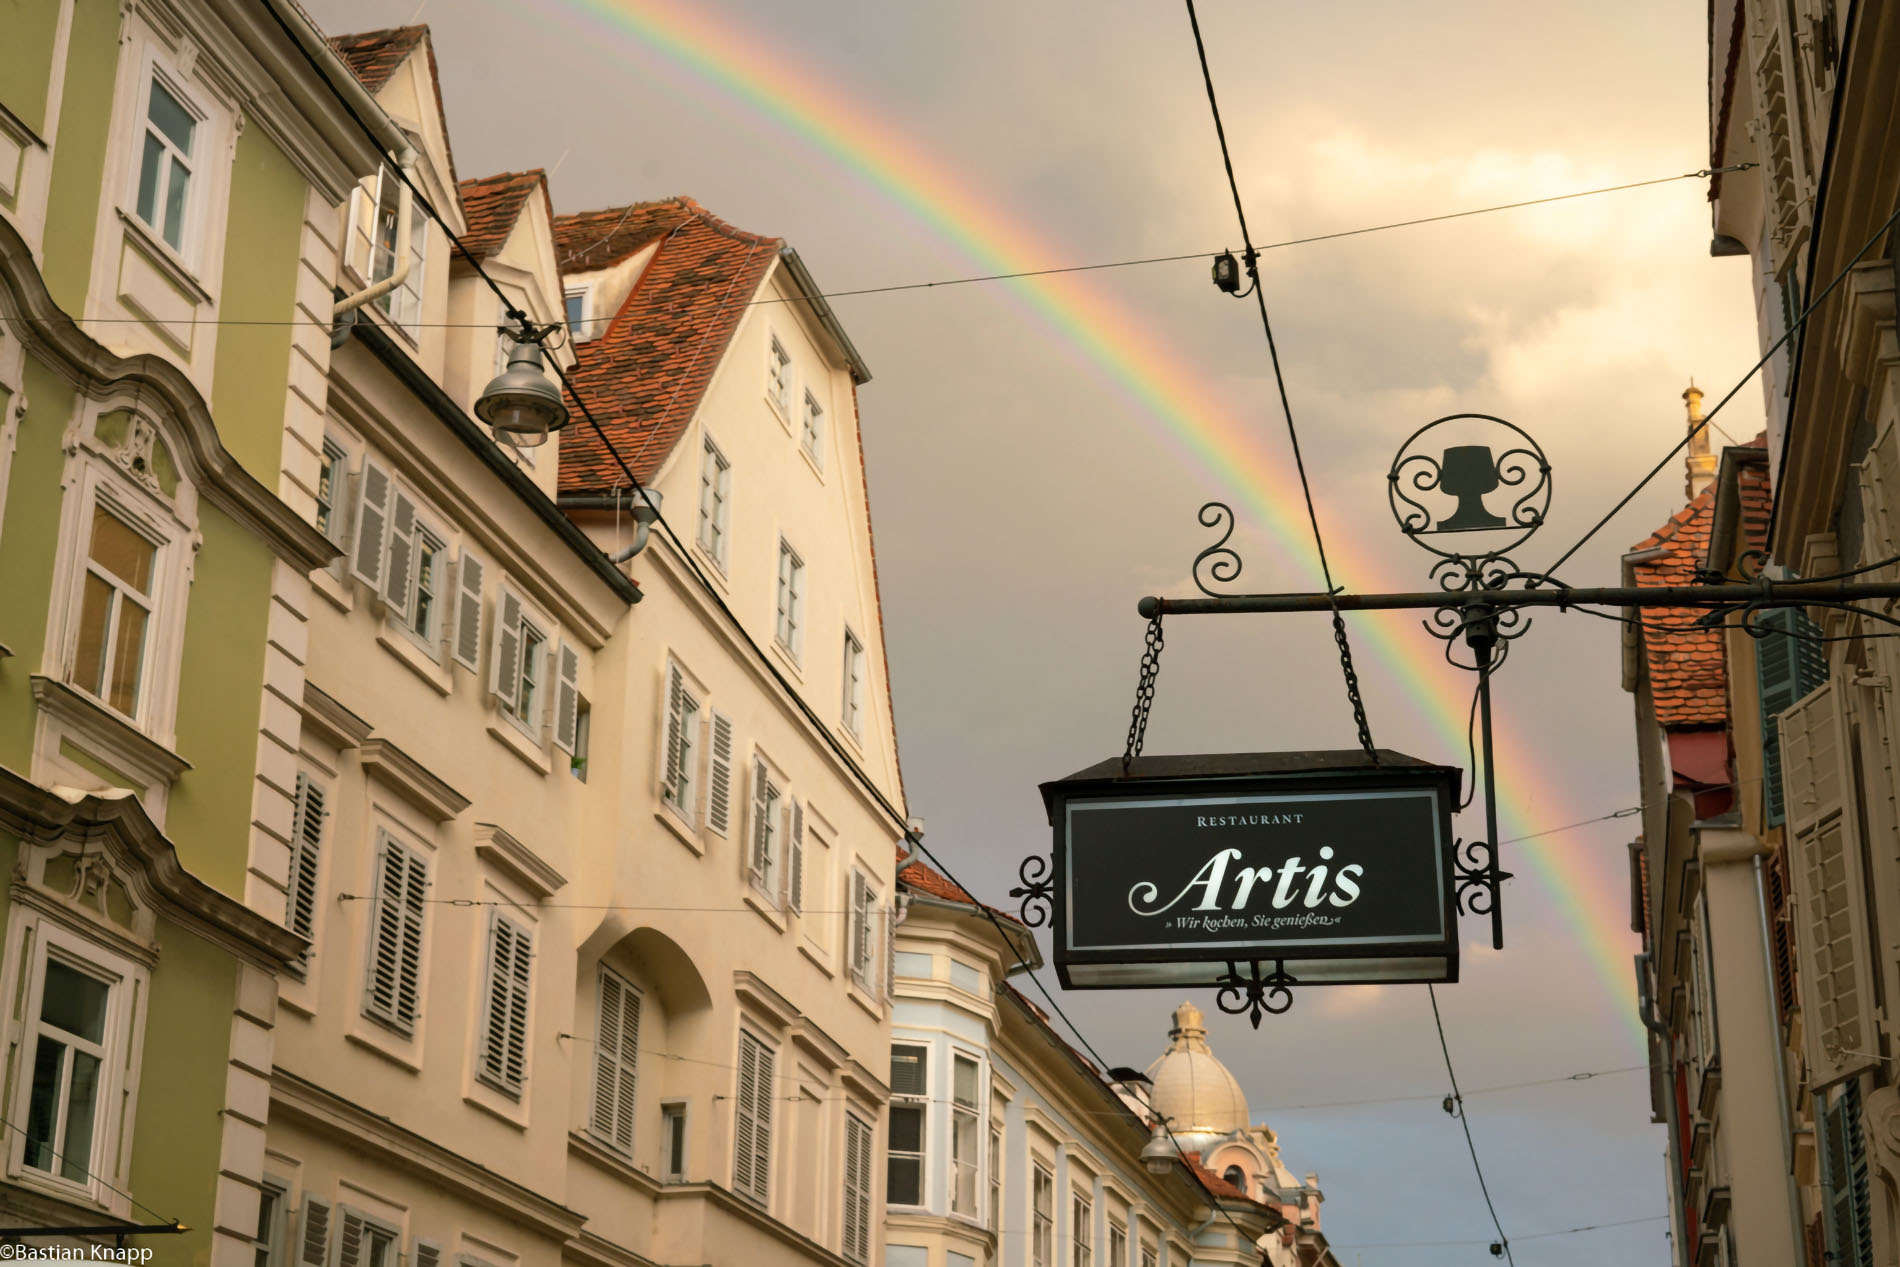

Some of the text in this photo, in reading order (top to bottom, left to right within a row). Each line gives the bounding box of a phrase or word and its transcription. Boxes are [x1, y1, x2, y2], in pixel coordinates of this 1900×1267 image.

[1196, 813, 1304, 828] RESTAURANT
[1127, 845, 1364, 917] Artis
[1202, 914, 1248, 933] kochen,
[1251, 914, 1271, 927] Sie
